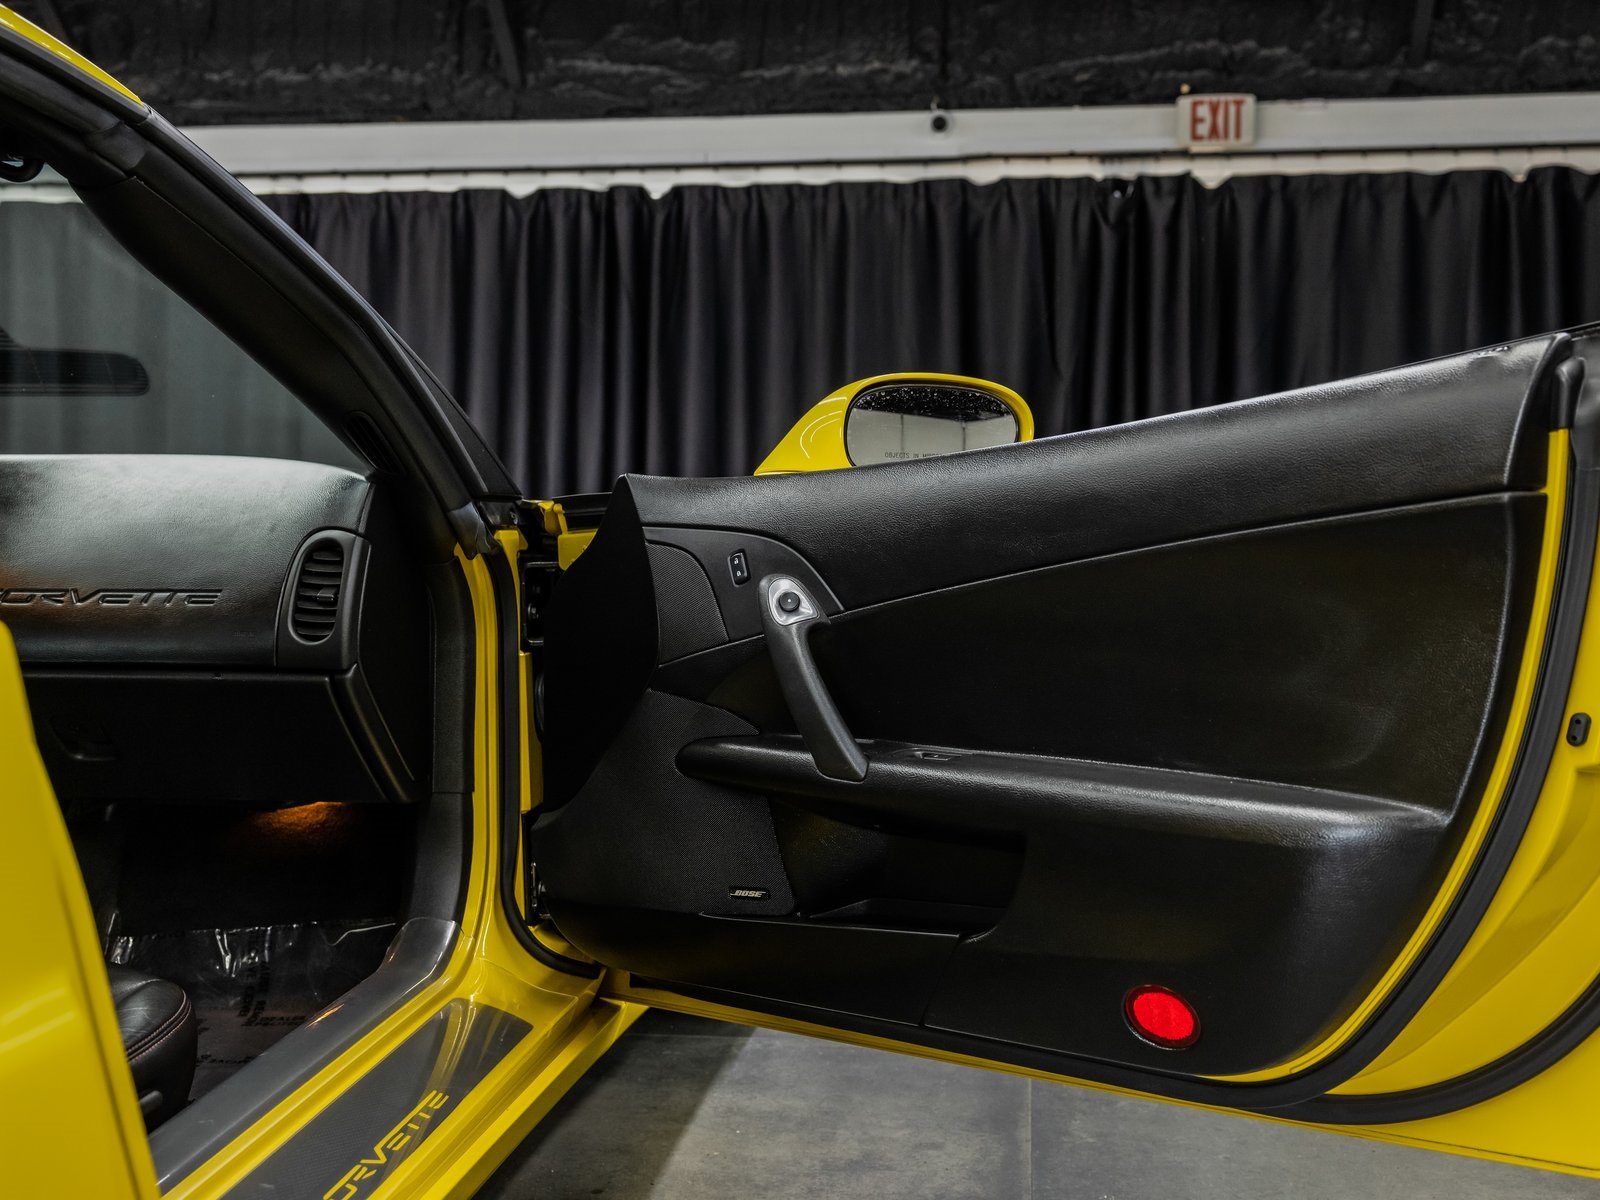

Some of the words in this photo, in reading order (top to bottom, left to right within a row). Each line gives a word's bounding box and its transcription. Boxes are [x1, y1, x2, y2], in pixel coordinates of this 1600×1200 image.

[1191, 98, 1245, 141] EXIT
[0, 588, 223, 606] ORVETTE
[730, 890, 766, 898] BOSE
